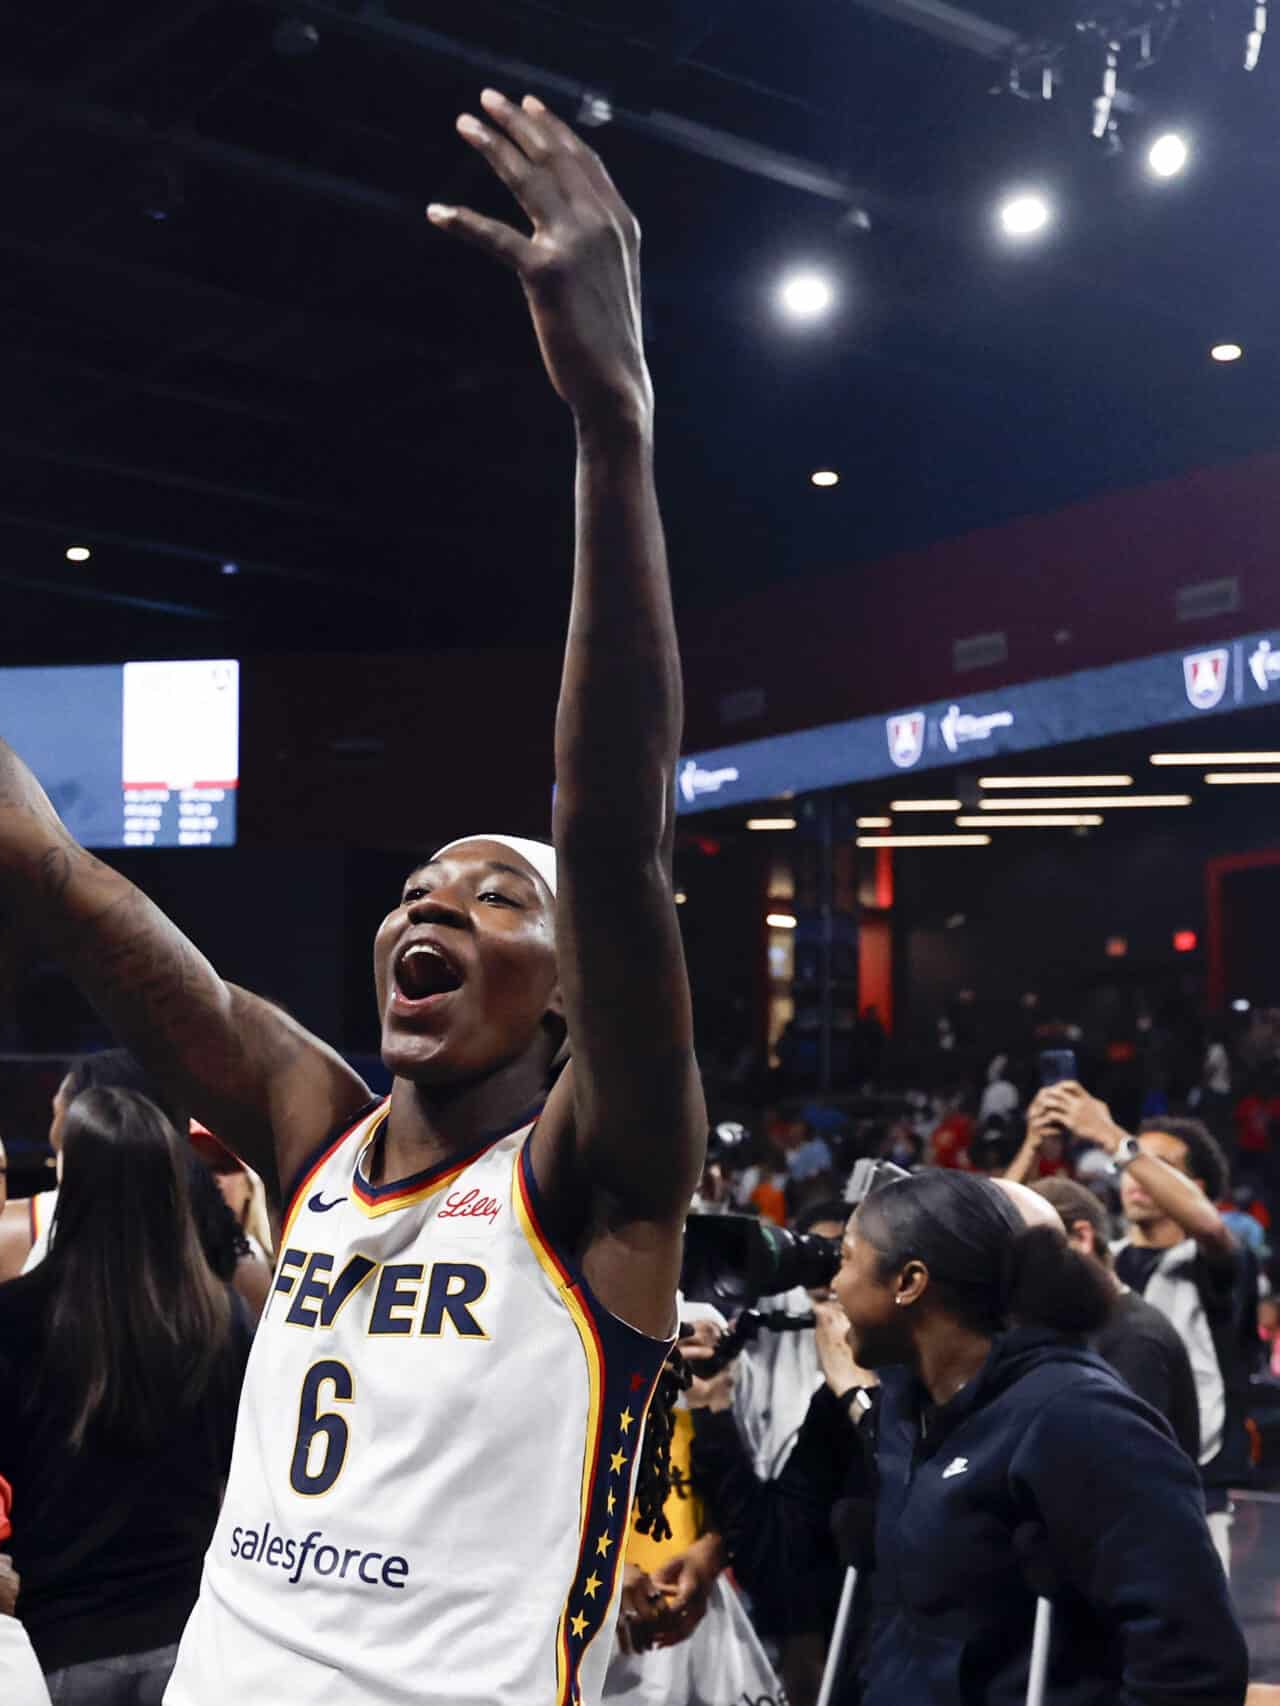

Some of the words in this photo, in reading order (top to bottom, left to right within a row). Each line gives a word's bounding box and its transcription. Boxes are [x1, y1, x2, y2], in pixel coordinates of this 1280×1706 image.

[437, 1188, 503, 1225] Lilly
[273, 1247, 490, 1339] FEVER
[289, 1358, 355, 1498] 6
[230, 1522, 409, 1589] salesforce
